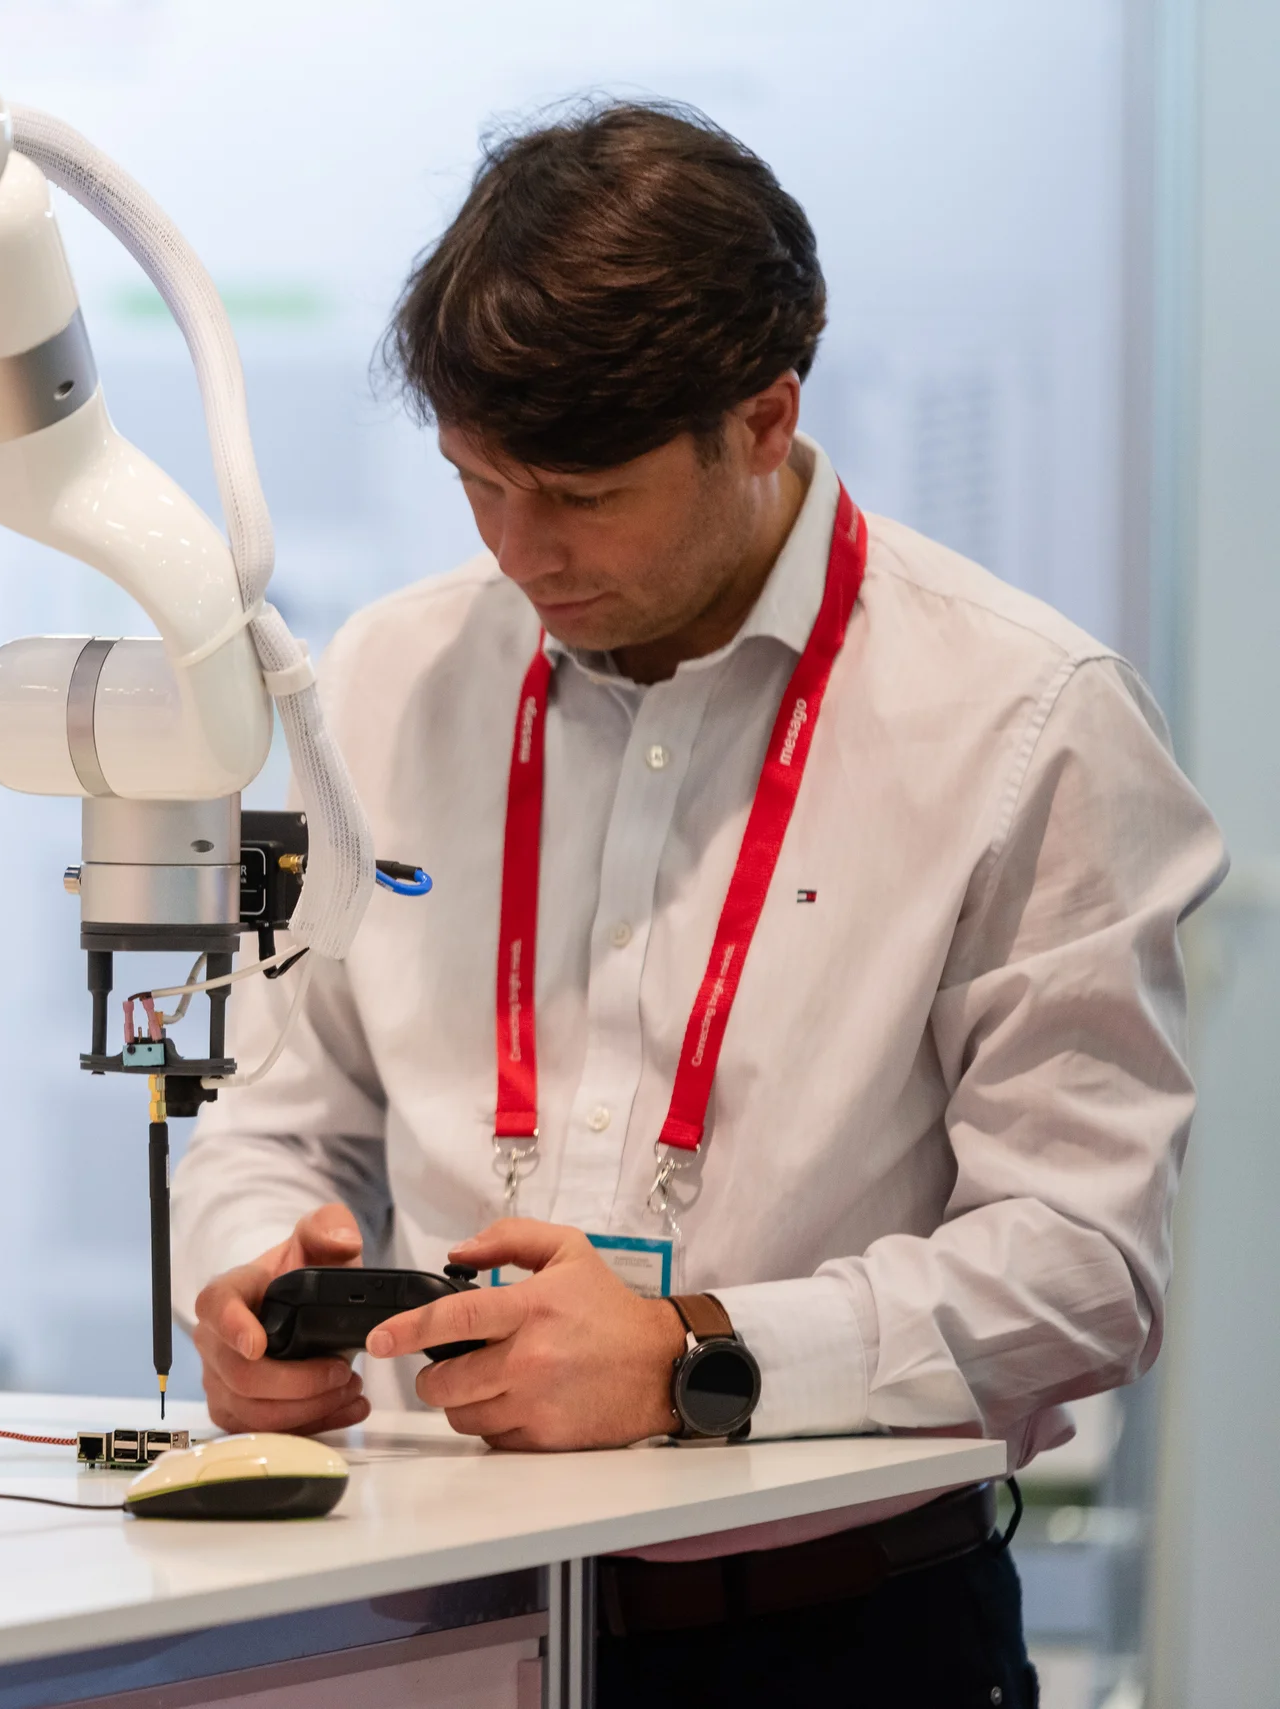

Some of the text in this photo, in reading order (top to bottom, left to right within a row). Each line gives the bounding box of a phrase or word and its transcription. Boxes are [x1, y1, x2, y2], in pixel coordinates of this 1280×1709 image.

[520, 696, 537, 763] mesago
[780, 697, 807, 767] mesago
[509, 972, 521, 1002] bright
[509, 1002, 521, 1061] Connecting
[691, 1006, 716, 1067] Connecting
[708, 977, 726, 1006] bright
